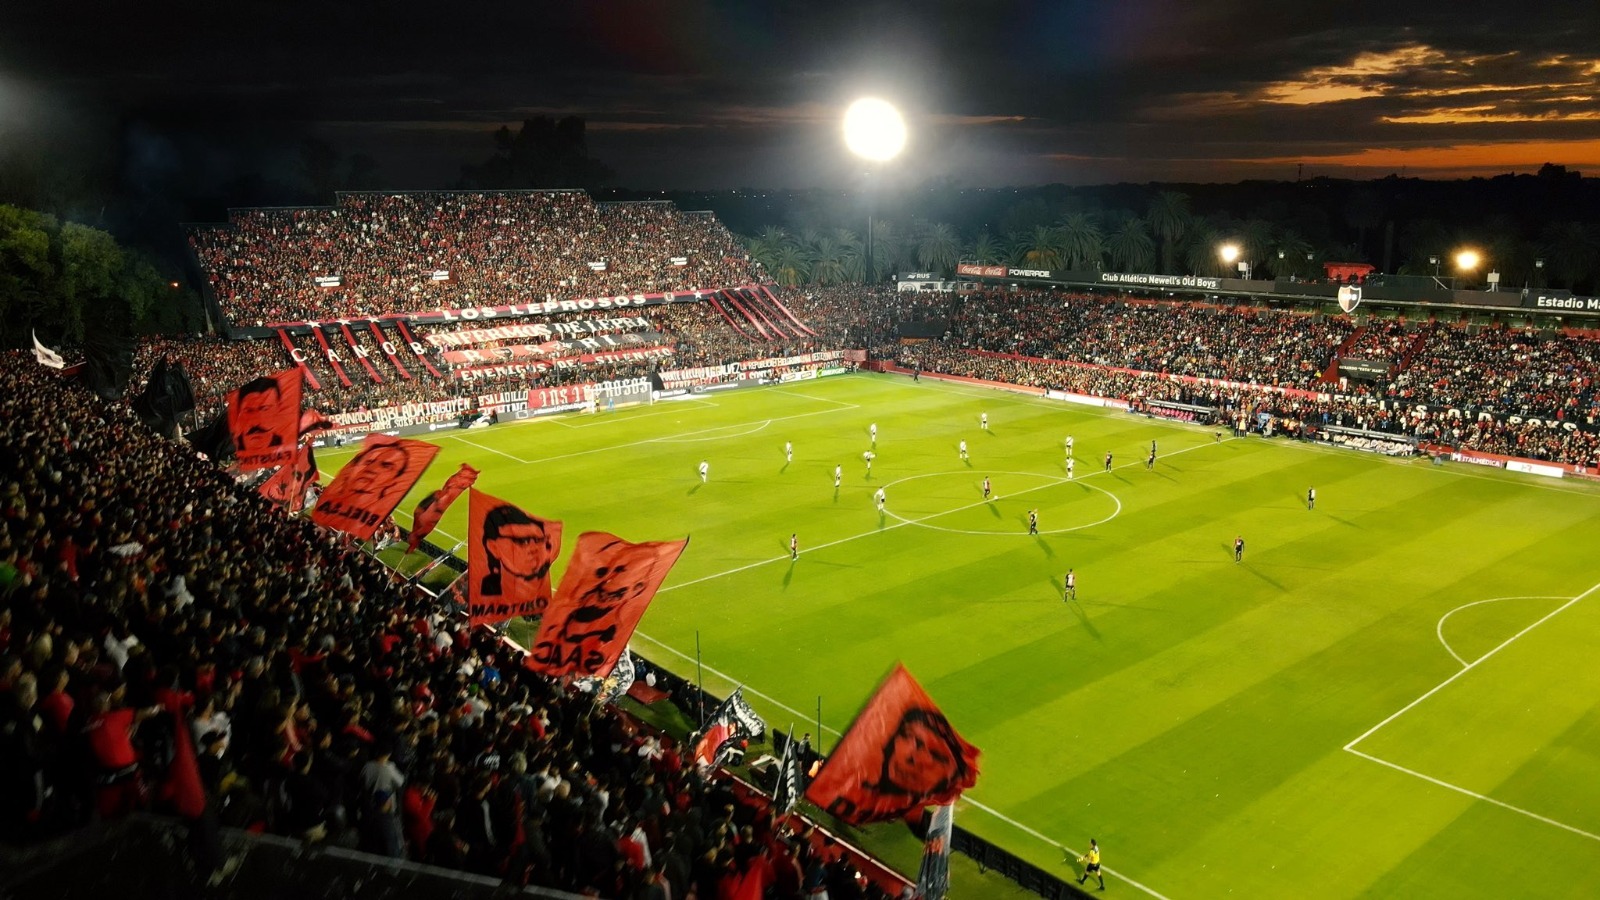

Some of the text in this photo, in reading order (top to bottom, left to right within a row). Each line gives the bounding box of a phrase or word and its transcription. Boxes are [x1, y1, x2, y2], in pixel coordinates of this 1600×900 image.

[961, 265, 982, 275] Coca-Cola
[984, 266, 1004, 276] Coca-Cola
[1008, 268, 1051, 278] POWERADE
[1102, 273, 1216, 289] Club Atlético Newell's Old Boys
[442, 294, 648, 321] LOS LEPROSOS
[1537, 296, 1600, 309] Estadio M
[424, 316, 650, 347] ENFERMOS DE LEPRA
[461, 363, 547, 381] ENEMIGOS
[595, 348, 672, 366] SILENCIO
[328, 411, 373, 426] GRANADA
[372, 403, 424, 423] TABLADA
[425, 397, 471, 416] IRIGOYEN
[349, 426, 369, 435] MESSI
[1509, 416, 1578, 432] BOYS
[1461, 456, 1501, 468] ITALMÉDICA
